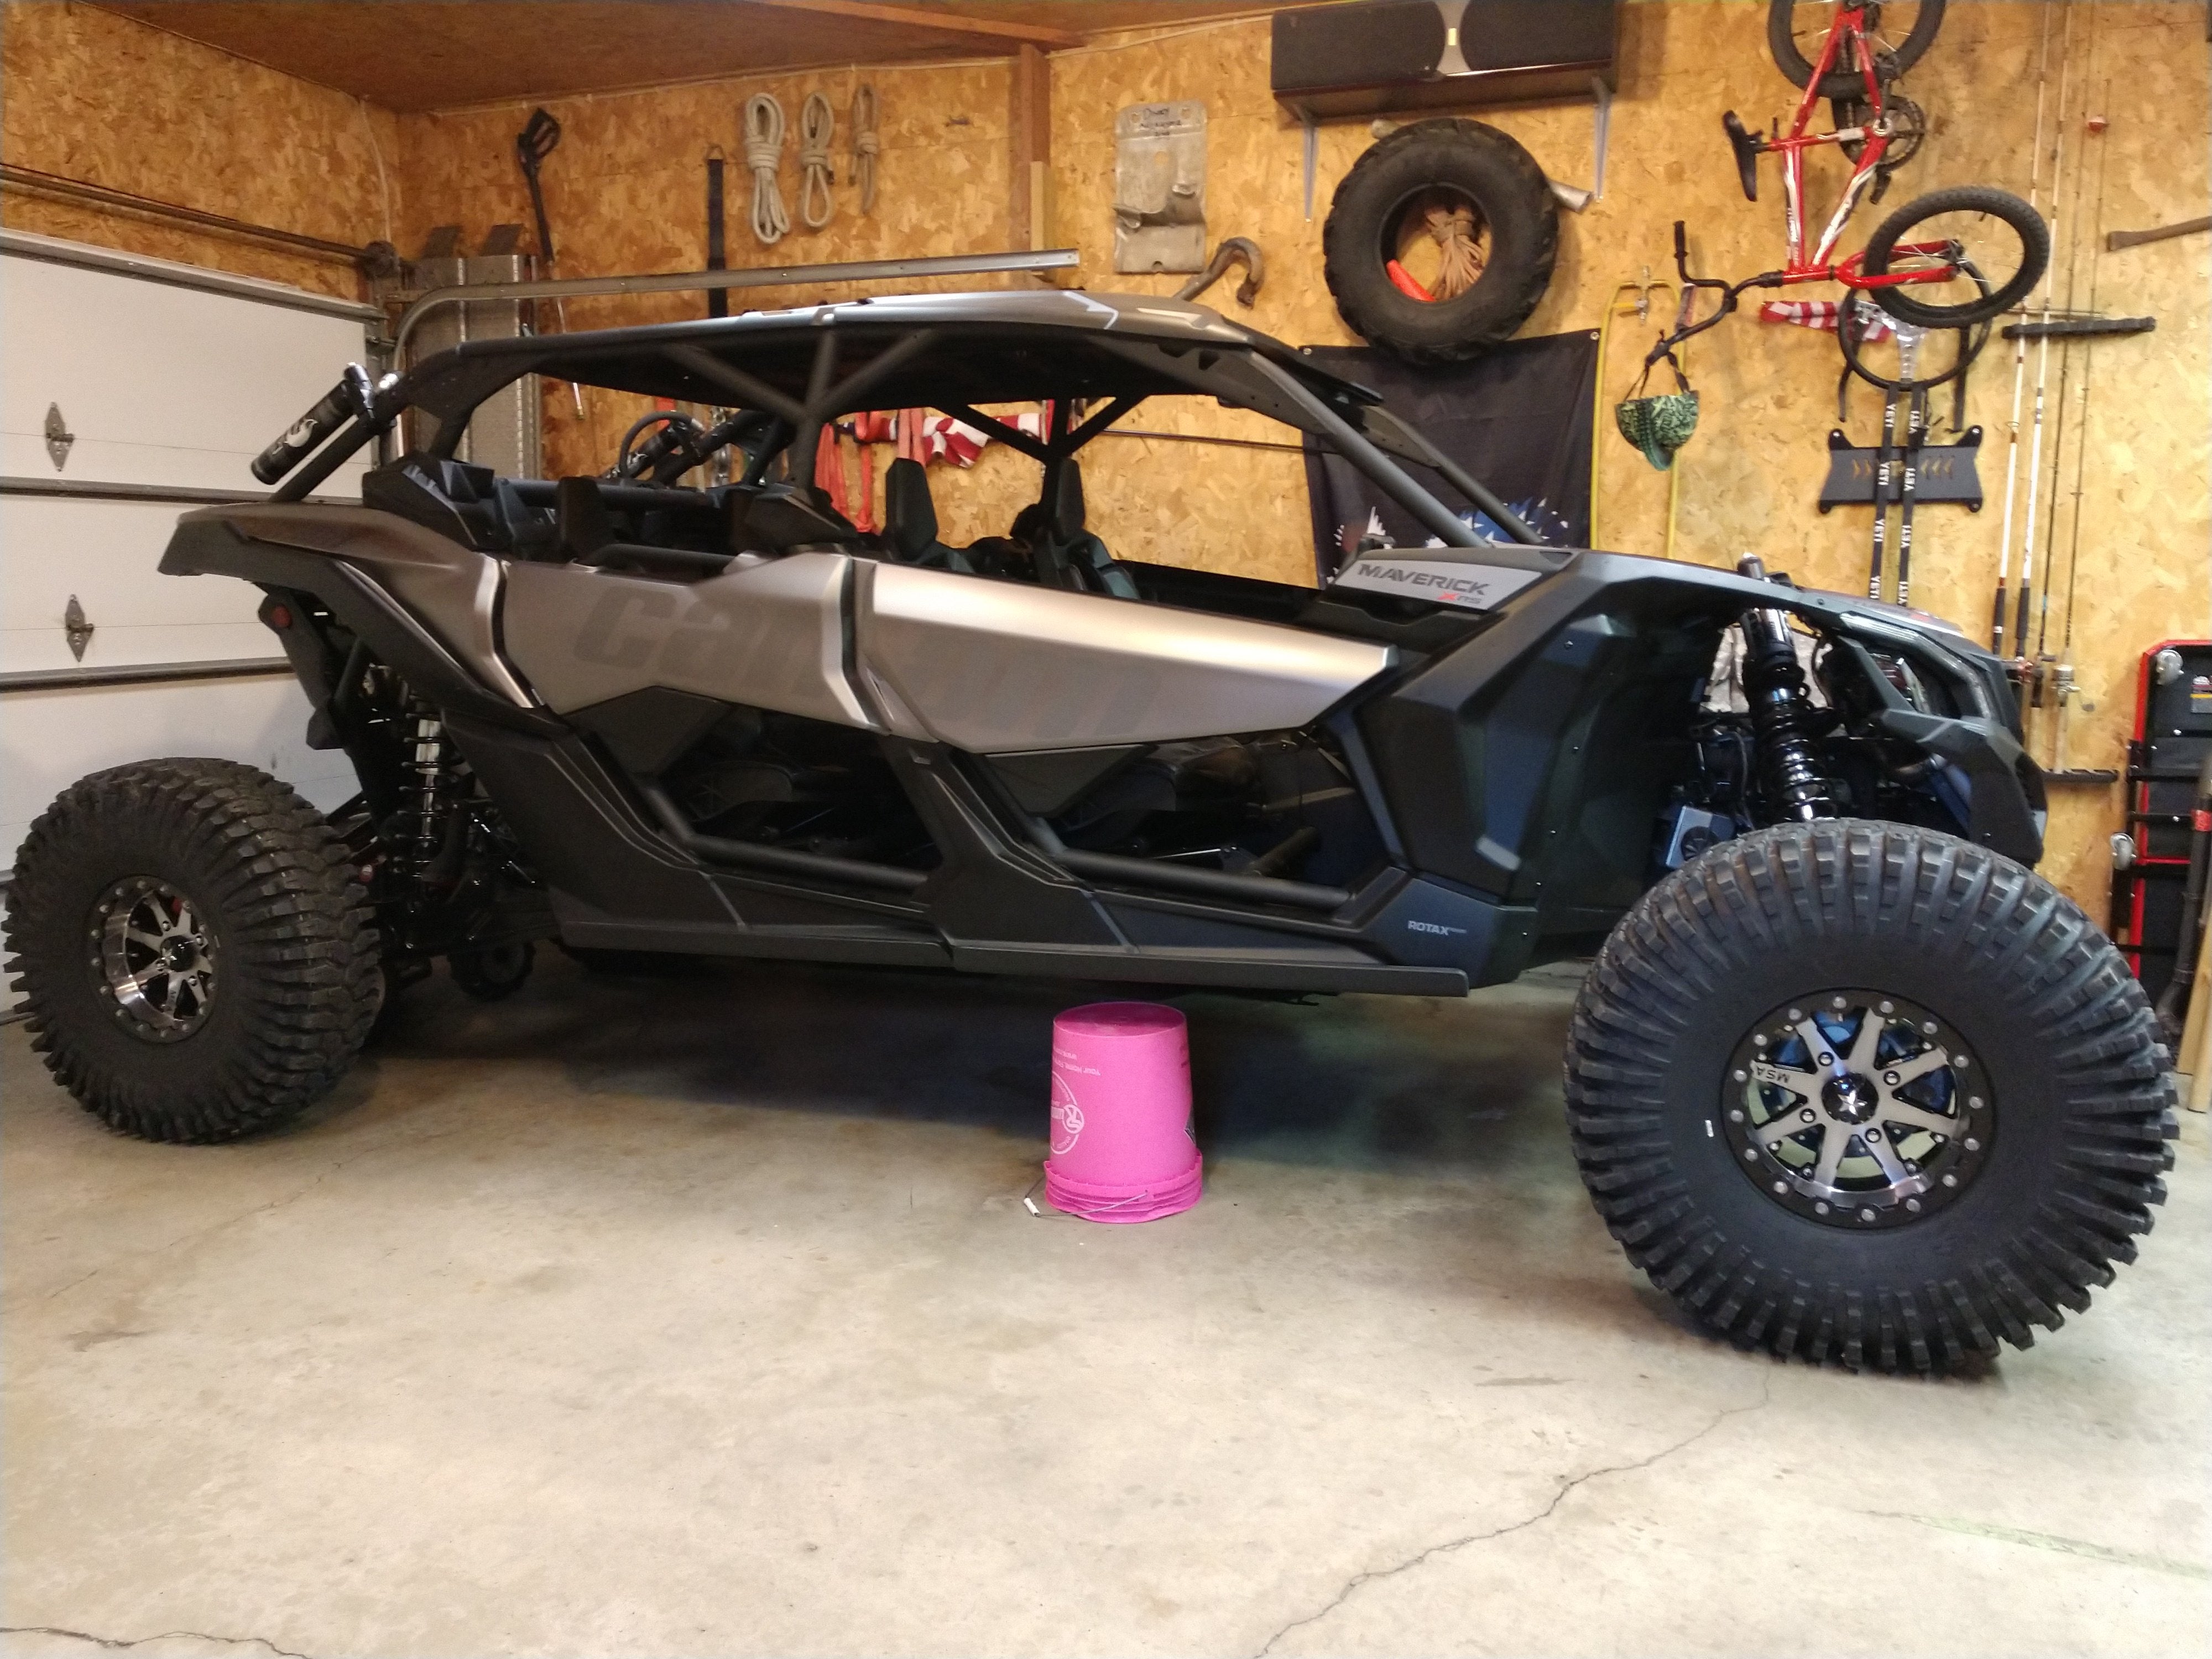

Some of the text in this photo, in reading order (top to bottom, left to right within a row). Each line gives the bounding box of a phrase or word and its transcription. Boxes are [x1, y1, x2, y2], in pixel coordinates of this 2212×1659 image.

[1885, 403, 1896, 427] YETI
[1908, 410, 1920, 435] YETI
[1878, 462, 1890, 486] YETI
[1903, 468, 1916, 491] YETI
[1874, 519, 1885, 542] YETI
[1901, 525, 1911, 548] YETI
[1358, 563, 1491, 596] MAVERICK
[1869, 576, 1881, 599] YETI
[1897, 581, 1908, 605] YETI
[1408, 920, 1449, 936] ROTAX
[1756, 1066, 1791, 1084] MSA
